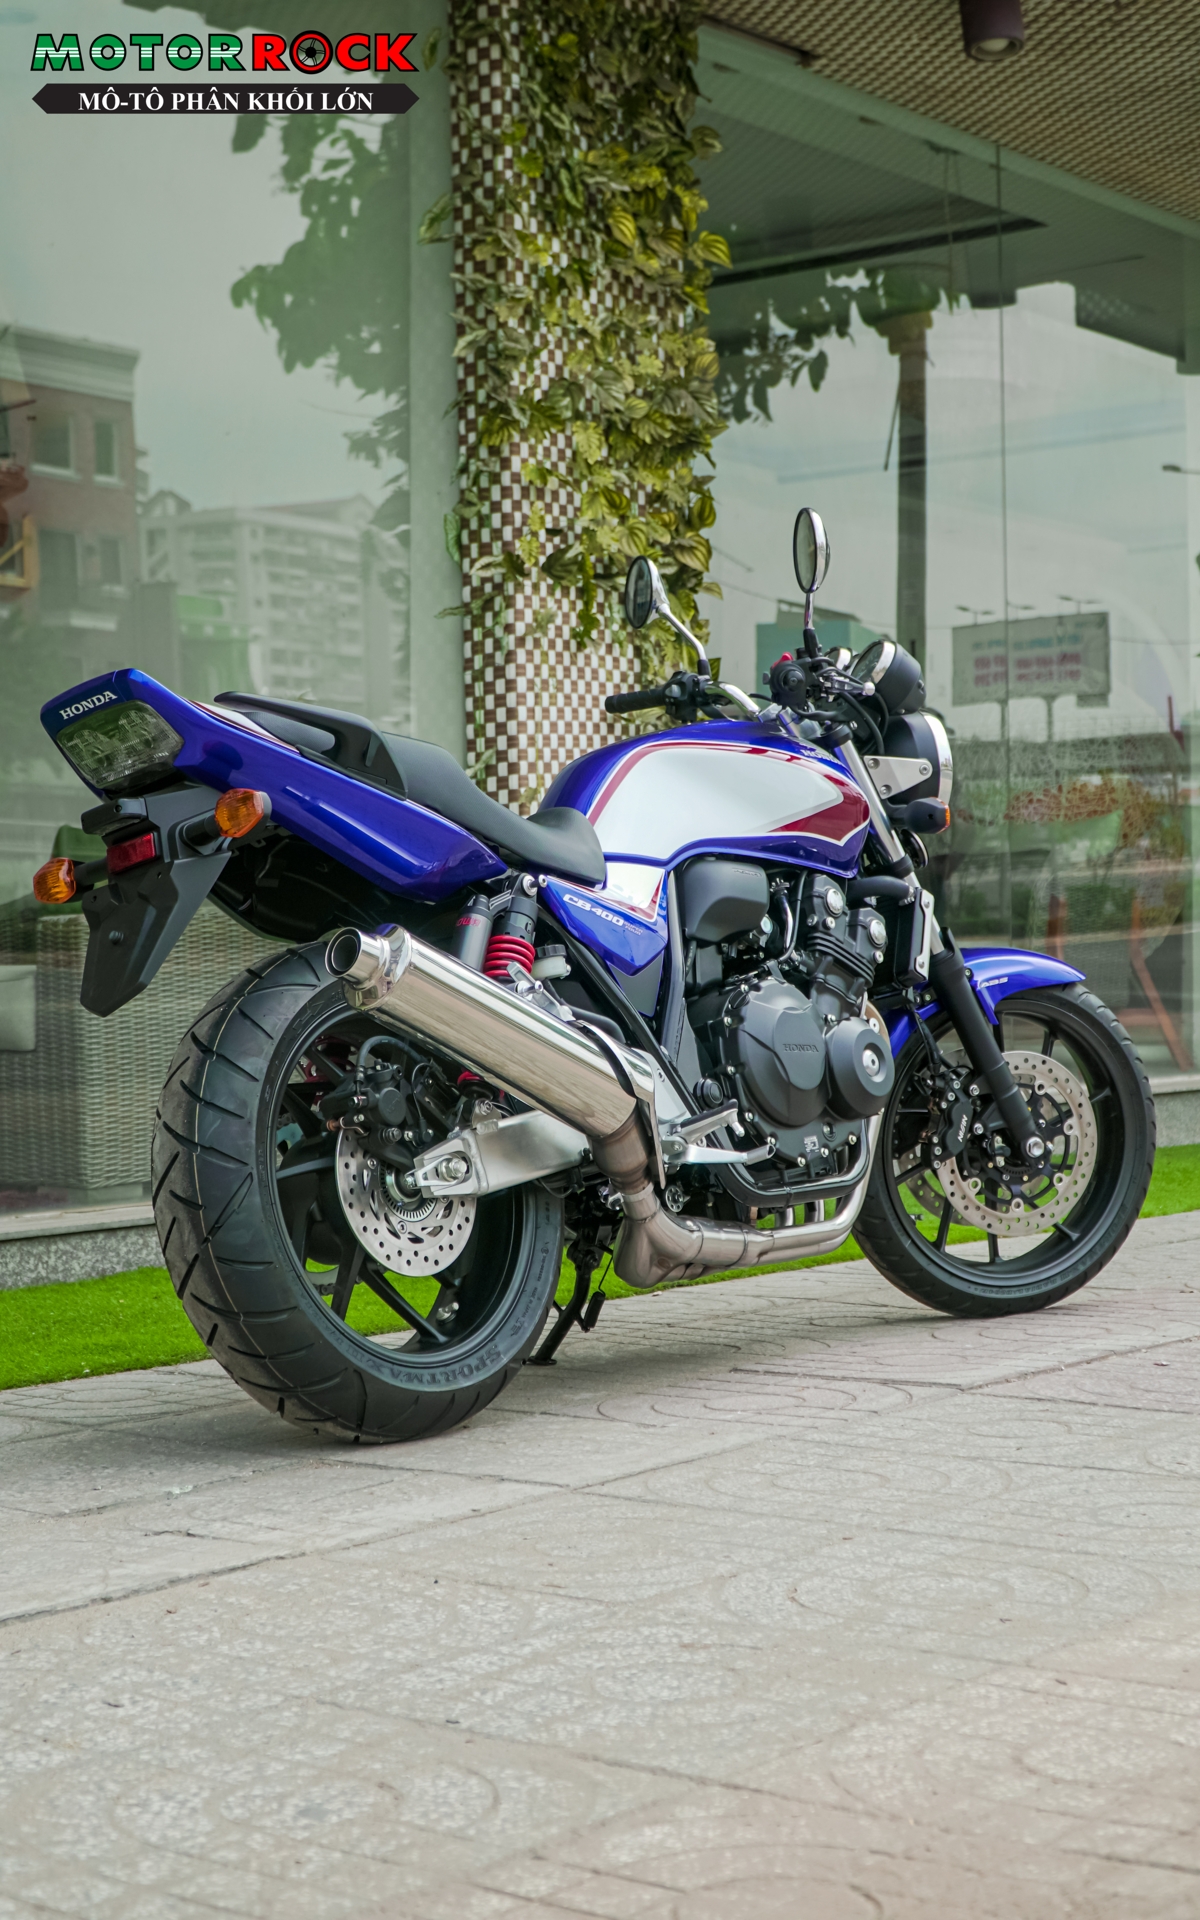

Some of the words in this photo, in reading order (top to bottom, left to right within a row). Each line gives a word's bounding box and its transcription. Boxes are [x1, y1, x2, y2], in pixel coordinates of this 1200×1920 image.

[59, 691, 118, 720] HONDA
[563, 893, 624, 926] CB400
[981, 977, 1008, 988] ABS
[782, 1043, 820, 1053] HONDA
